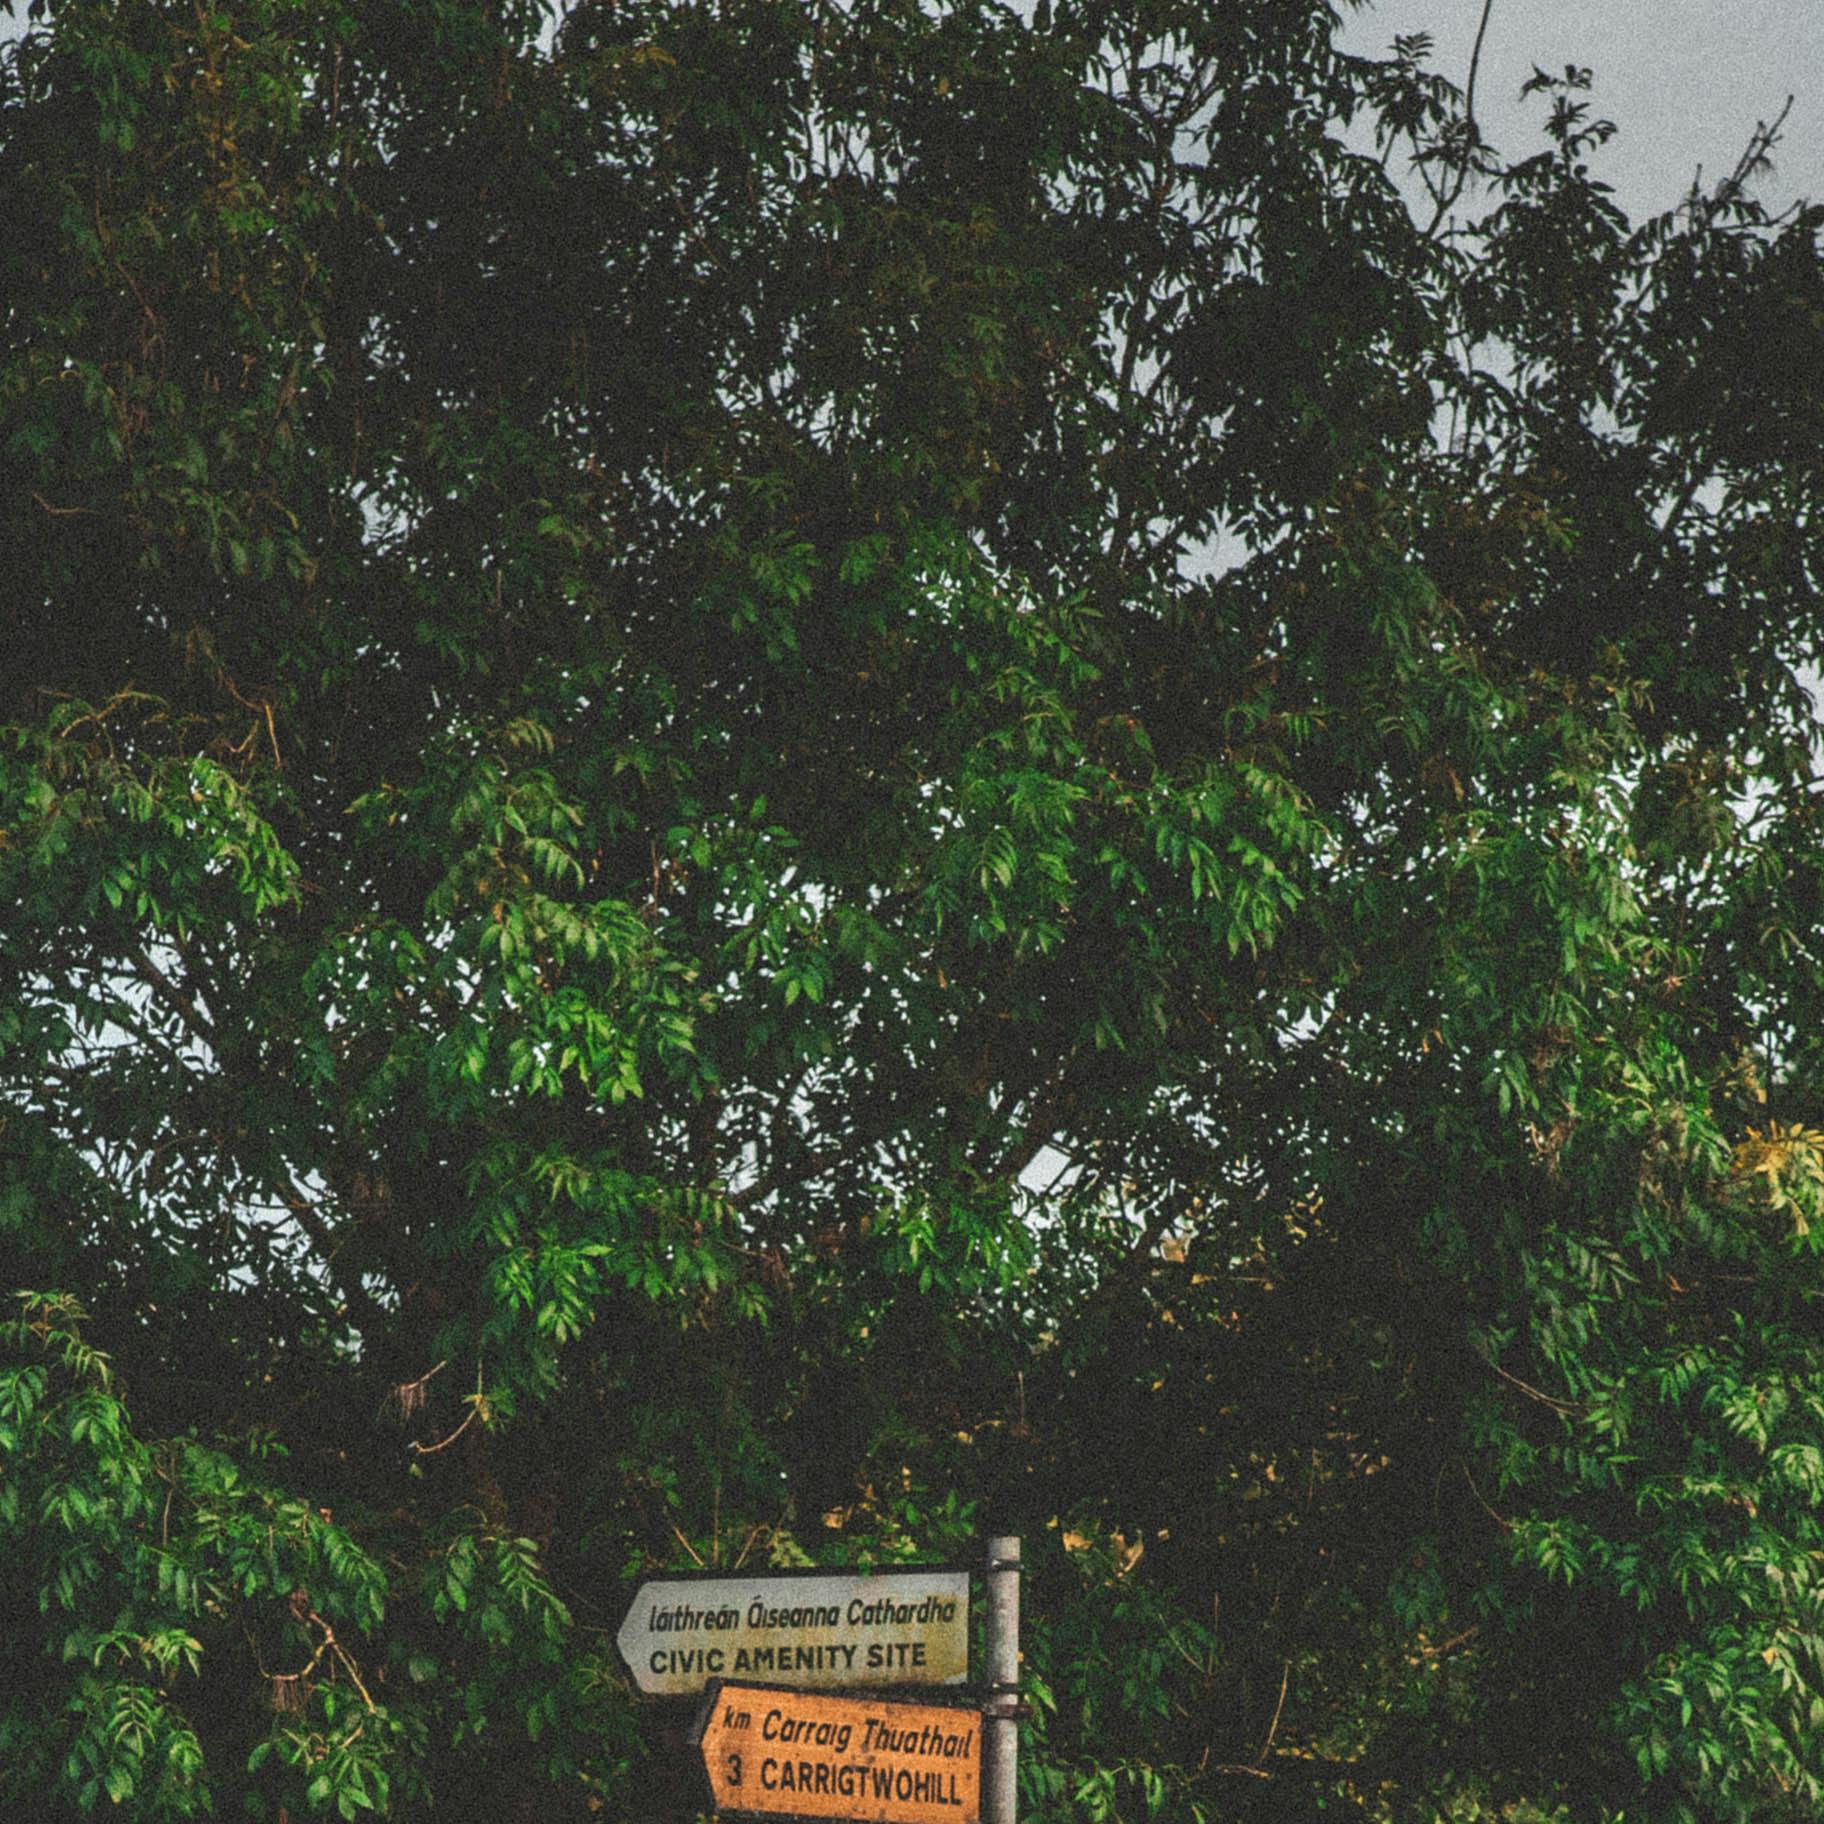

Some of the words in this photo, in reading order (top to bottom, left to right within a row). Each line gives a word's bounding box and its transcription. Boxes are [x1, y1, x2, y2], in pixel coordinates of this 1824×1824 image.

[649, 1649, 725, 1674] CIVIC
[734, 1643, 856, 1672] AMENITY
[866, 1642, 927, 1668] SITE
[722, 1706, 751, 1730] km
[762, 1710, 852, 1752] Carraig
[864, 1718, 972, 1760] Thuathail
[727, 1755, 742, 1786] 3
[761, 1758, 962, 1806] CARRIGTWOHILL
